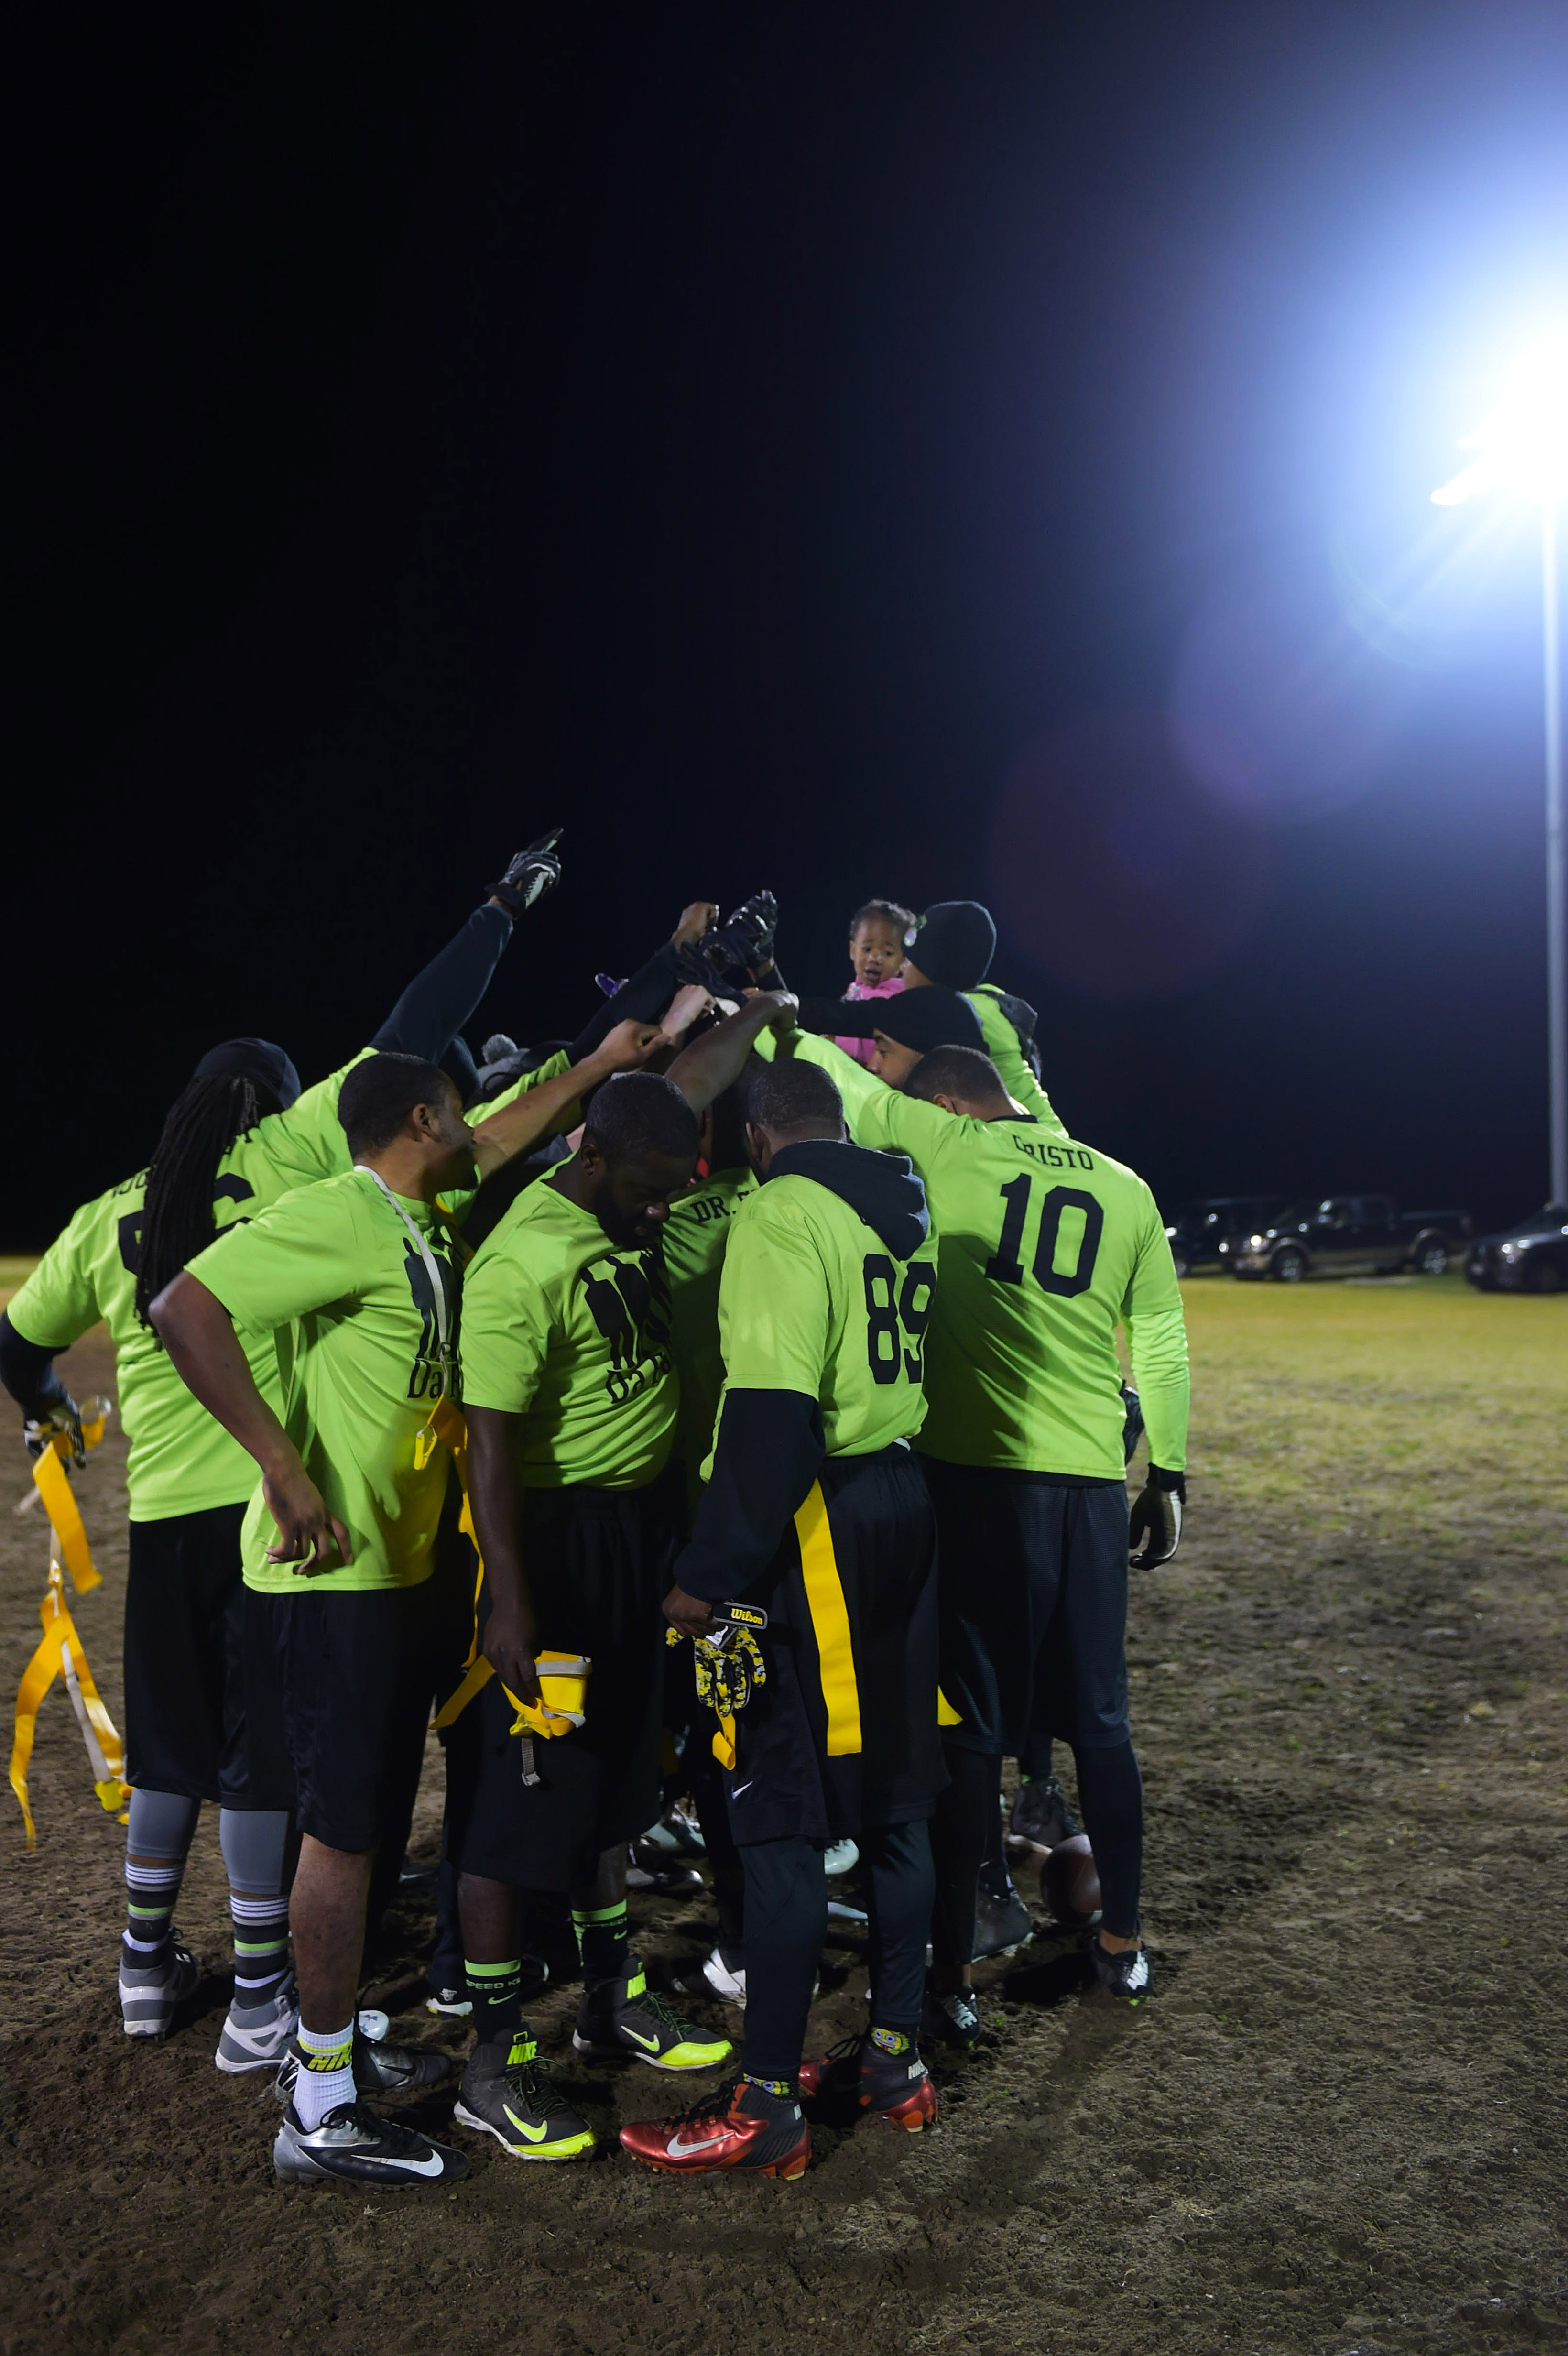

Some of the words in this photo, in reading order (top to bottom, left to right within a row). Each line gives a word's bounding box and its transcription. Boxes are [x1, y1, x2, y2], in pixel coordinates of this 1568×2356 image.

[1012, 1134, 1094, 1170] CRISTO
[690, 1196, 736, 1222] DR.
[985, 1173, 1104, 1298] 10
[863, 1254, 936, 1385] 89
[730, 1608, 763, 1625] Wilson
